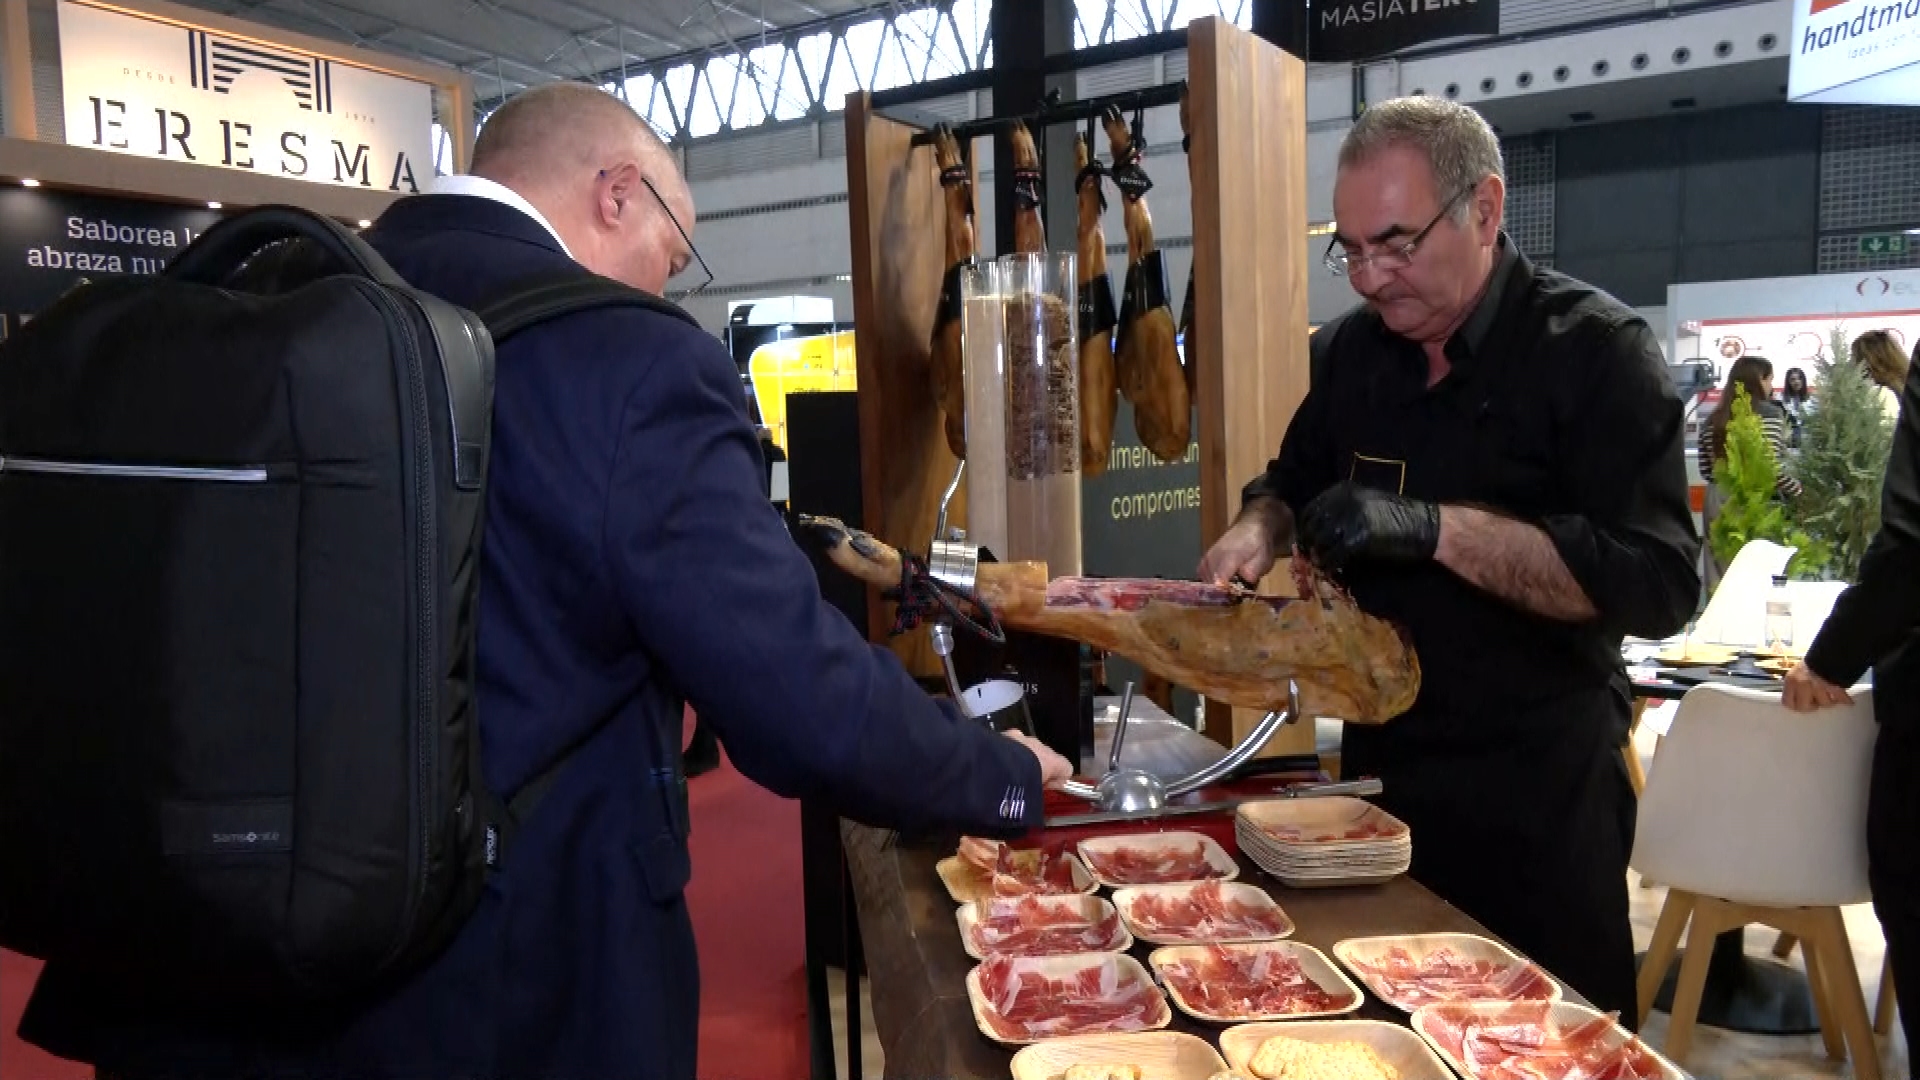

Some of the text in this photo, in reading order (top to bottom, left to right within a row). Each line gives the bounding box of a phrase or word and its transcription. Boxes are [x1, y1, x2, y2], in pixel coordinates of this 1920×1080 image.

[88, 96, 420, 193] ERESMA
[67, 216, 177, 247] Saborea
[27, 245, 124, 273] abraza
